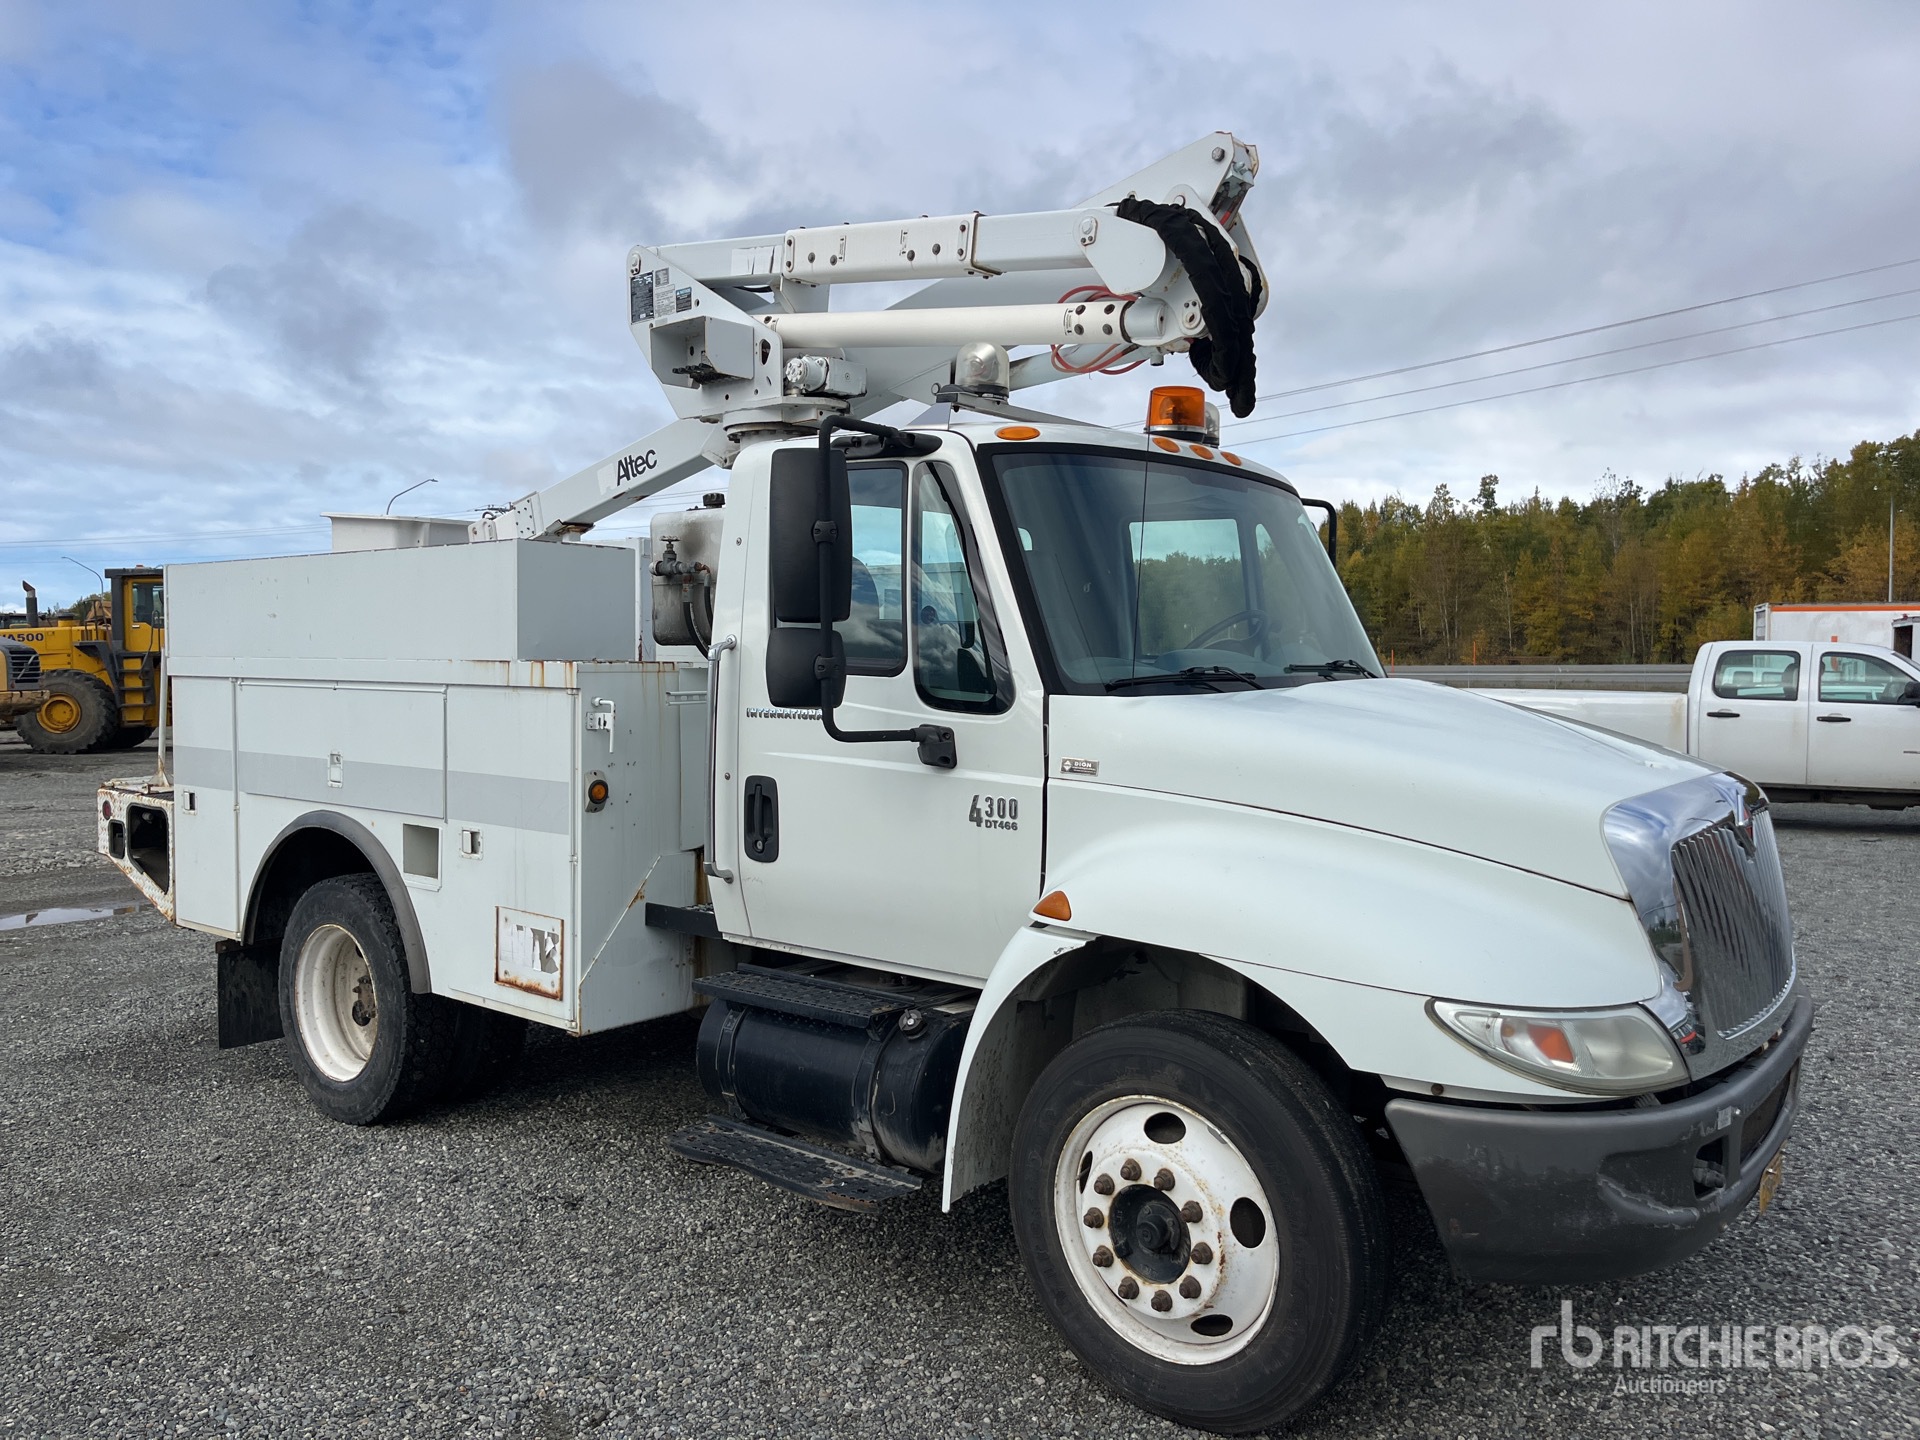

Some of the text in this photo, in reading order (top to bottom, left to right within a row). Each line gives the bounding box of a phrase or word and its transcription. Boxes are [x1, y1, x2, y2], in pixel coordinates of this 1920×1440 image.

[616, 449, 658, 487] Altec
[0, 632, 44, 642] A500
[746, 707, 823, 721] INTERNATIONA
[984, 819, 1018, 831] DT466
